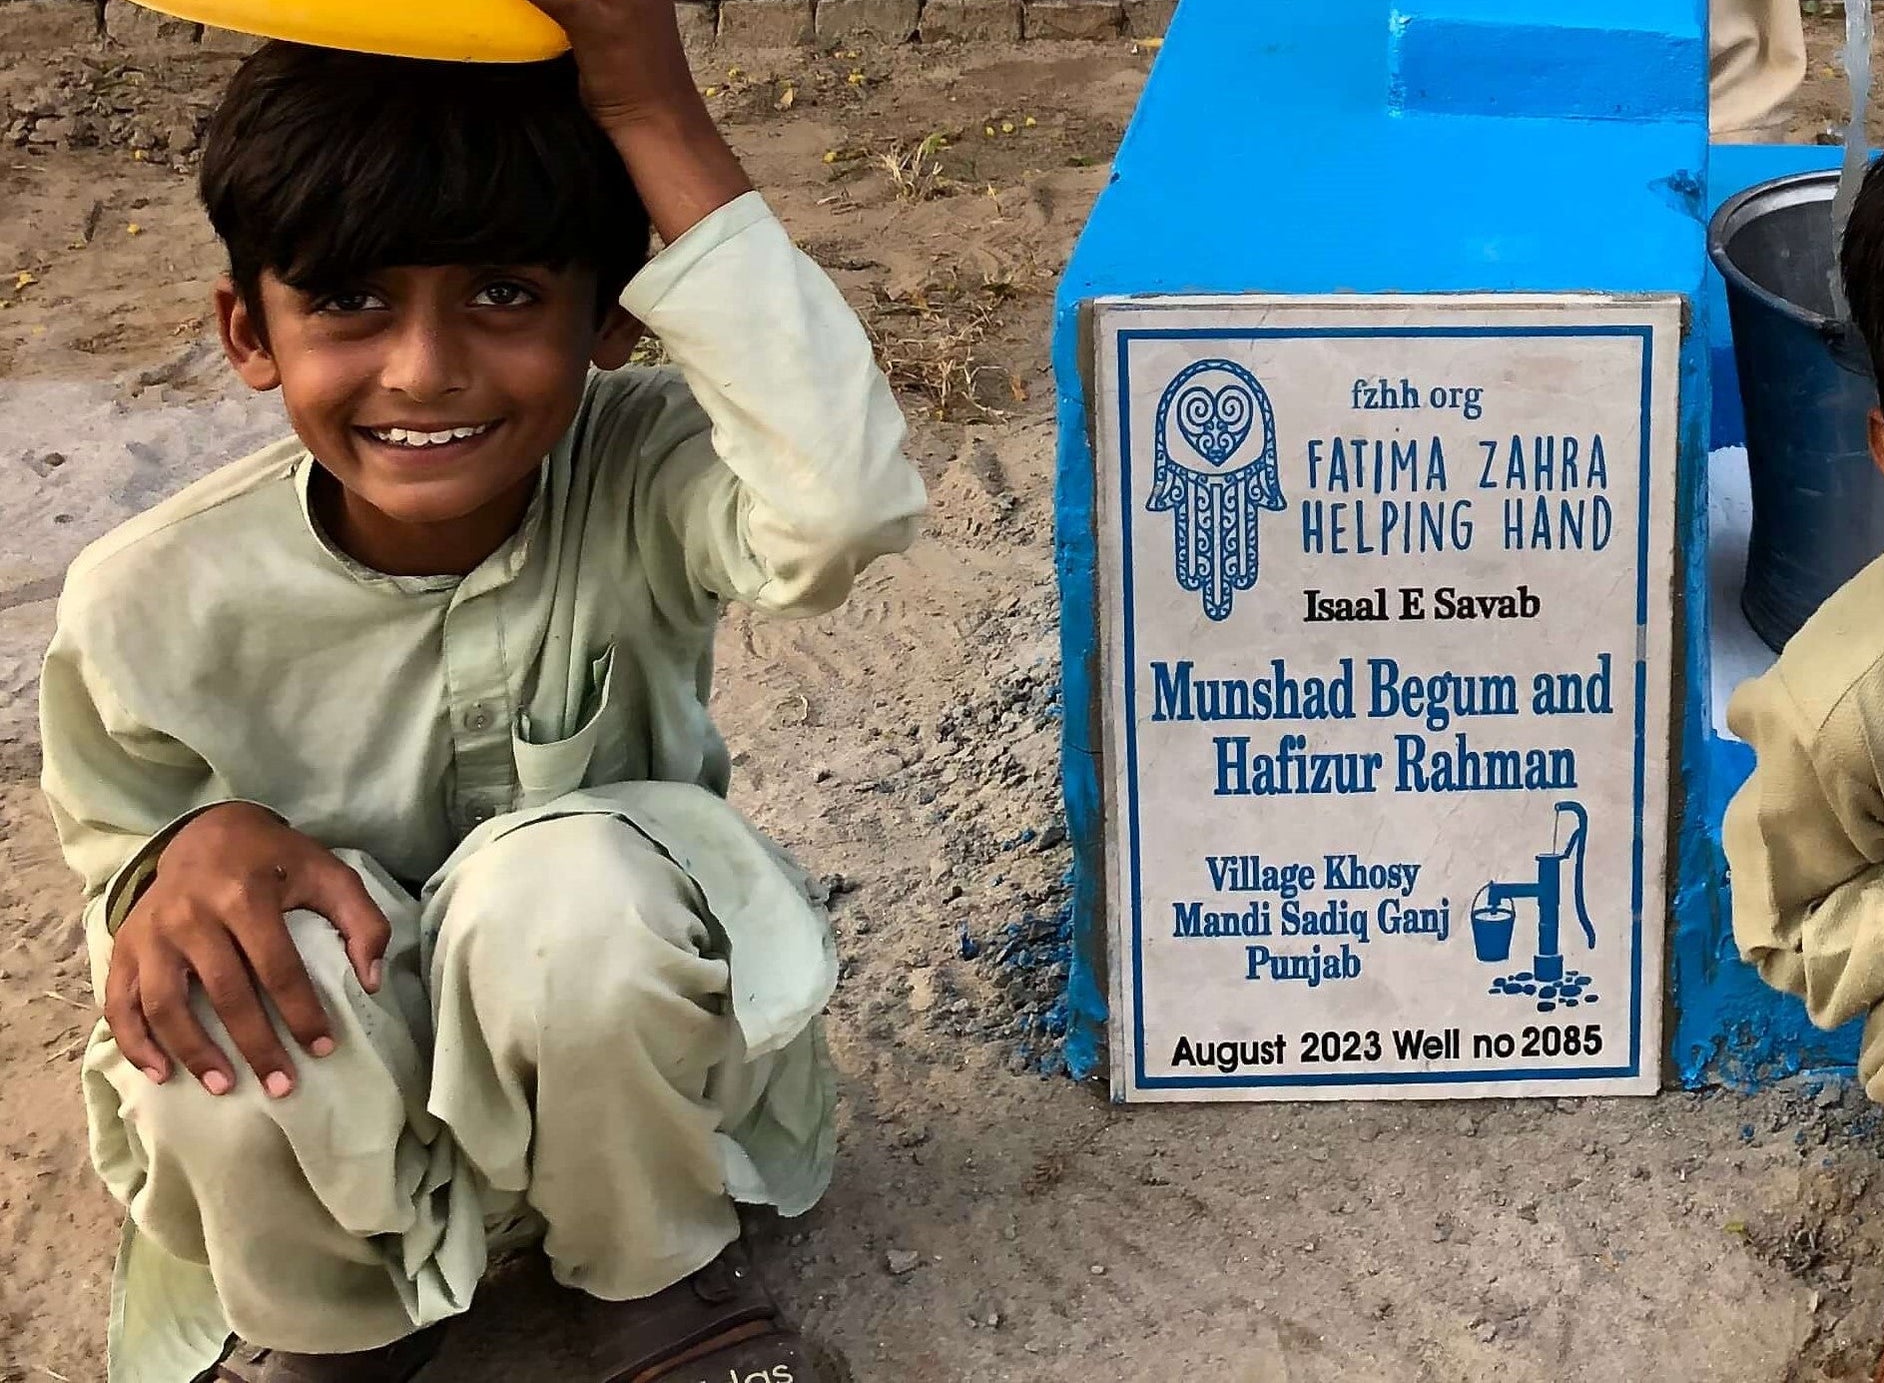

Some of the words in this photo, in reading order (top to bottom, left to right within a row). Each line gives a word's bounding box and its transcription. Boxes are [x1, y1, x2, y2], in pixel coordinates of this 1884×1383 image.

[1352, 379, 1420, 409] fzhh
[1430, 388, 1483, 419] org
[1308, 436, 1446, 494] FATIMA
[1479, 434, 1606, 491] ZAHRA
[1302, 500, 1472, 555] HELPING
[1505, 495, 1611, 551] HAND
[1303, 588, 1389, 622] Isaal
[1399, 587, 1426, 621] E
[1435, 585, 1540, 619] Savab
[1150, 658, 1356, 721] Munshad
[1367, 659, 1519, 732] Begum
[1533, 653, 1613, 715] and
[1213, 735, 1382, 795] Hafizur
[1394, 733, 1578, 792] Rahman
[1205, 856, 1315, 898] Village
[1324, 855, 1421, 897] Khosy
[1172, 901, 1272, 937] Mandi
[1281, 901, 1370, 943] Sadiq
[1378, 898, 1449, 941] Ganj
[1245, 944, 1361, 987] Punjab
[1171, 1035, 1286, 1073] August
[1301, 1031, 1381, 1062] 2023
[1393, 1029, 1459, 1060] Well
[1474, 1034, 1515, 1058] no
[1522, 1025, 1602, 1056] 2085
